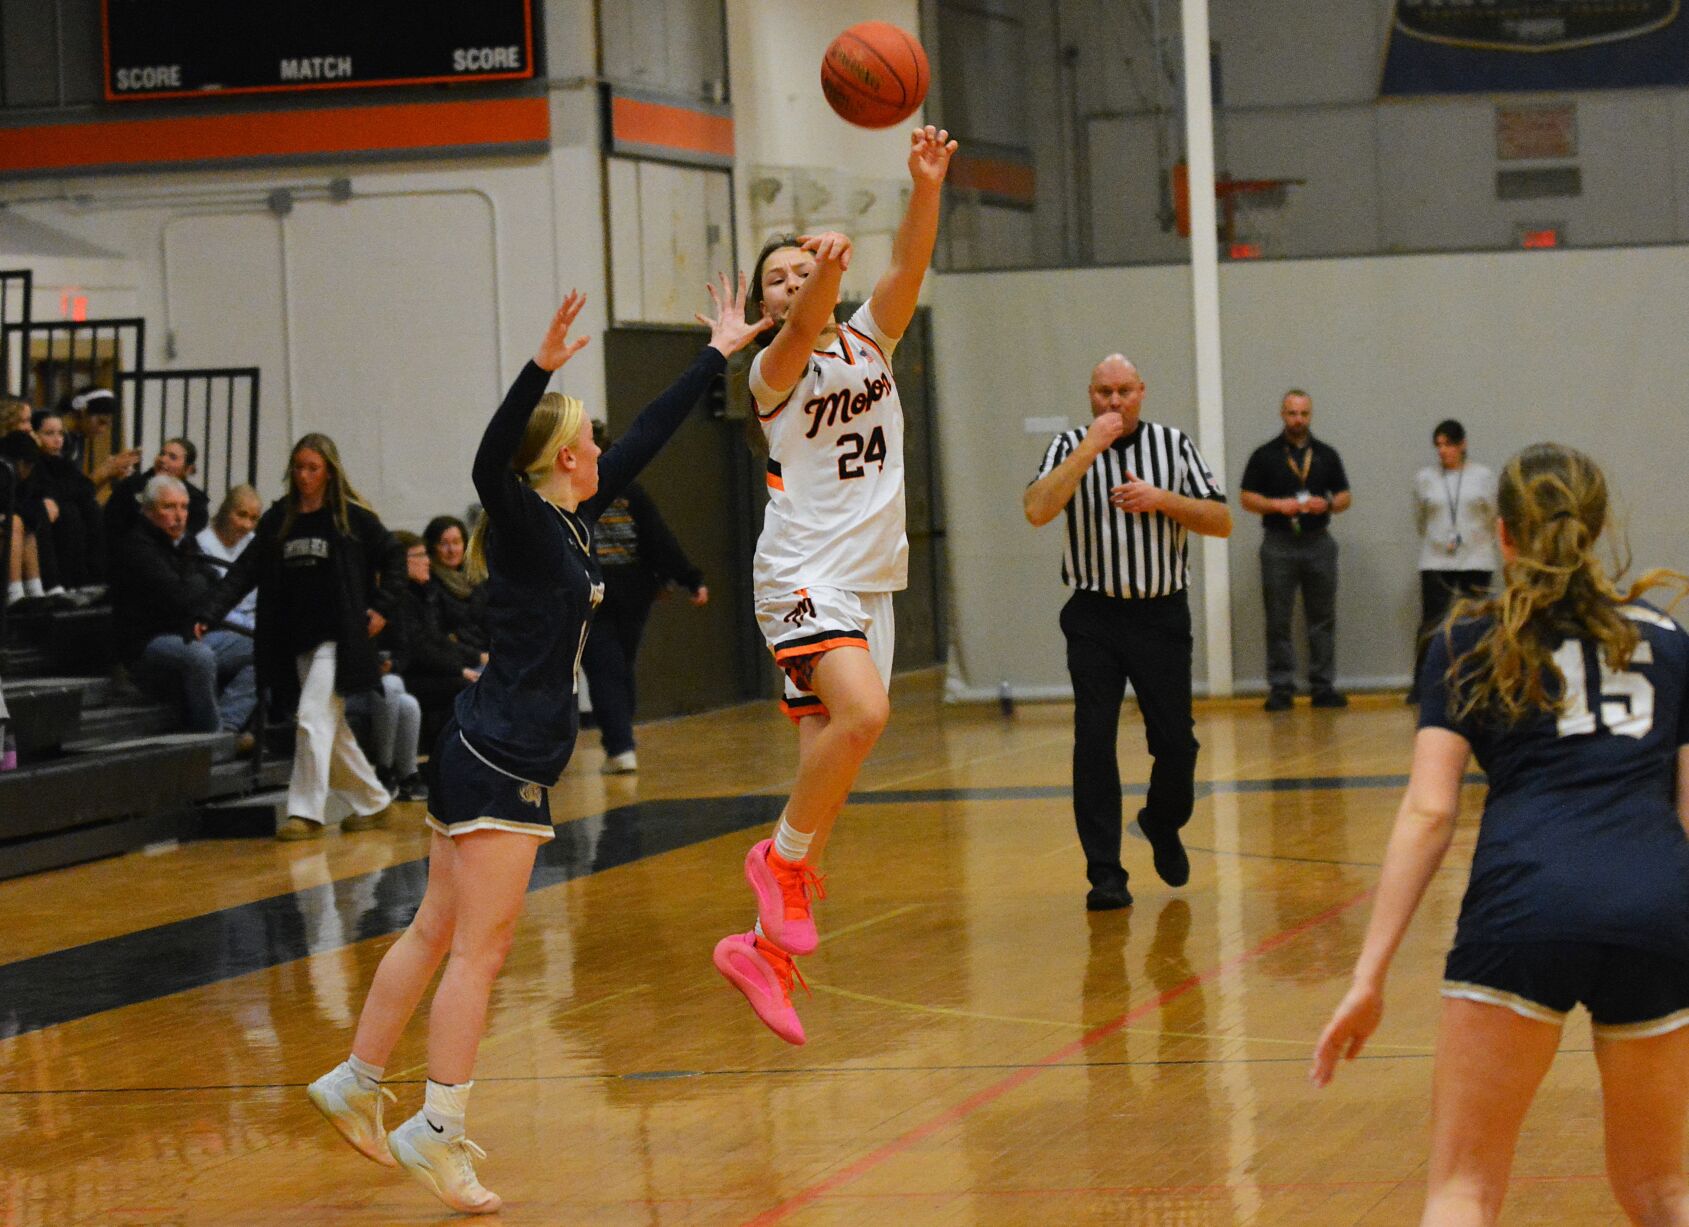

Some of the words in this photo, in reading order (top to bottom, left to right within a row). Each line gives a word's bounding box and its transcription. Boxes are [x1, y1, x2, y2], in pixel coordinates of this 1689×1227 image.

[280, 56, 352, 80] MATCH
[453, 46, 520, 71] SCORE
[117, 66, 181, 90] SCORE
[836, 426, 887, 480] 24
[1551, 638, 1655, 740] 15
